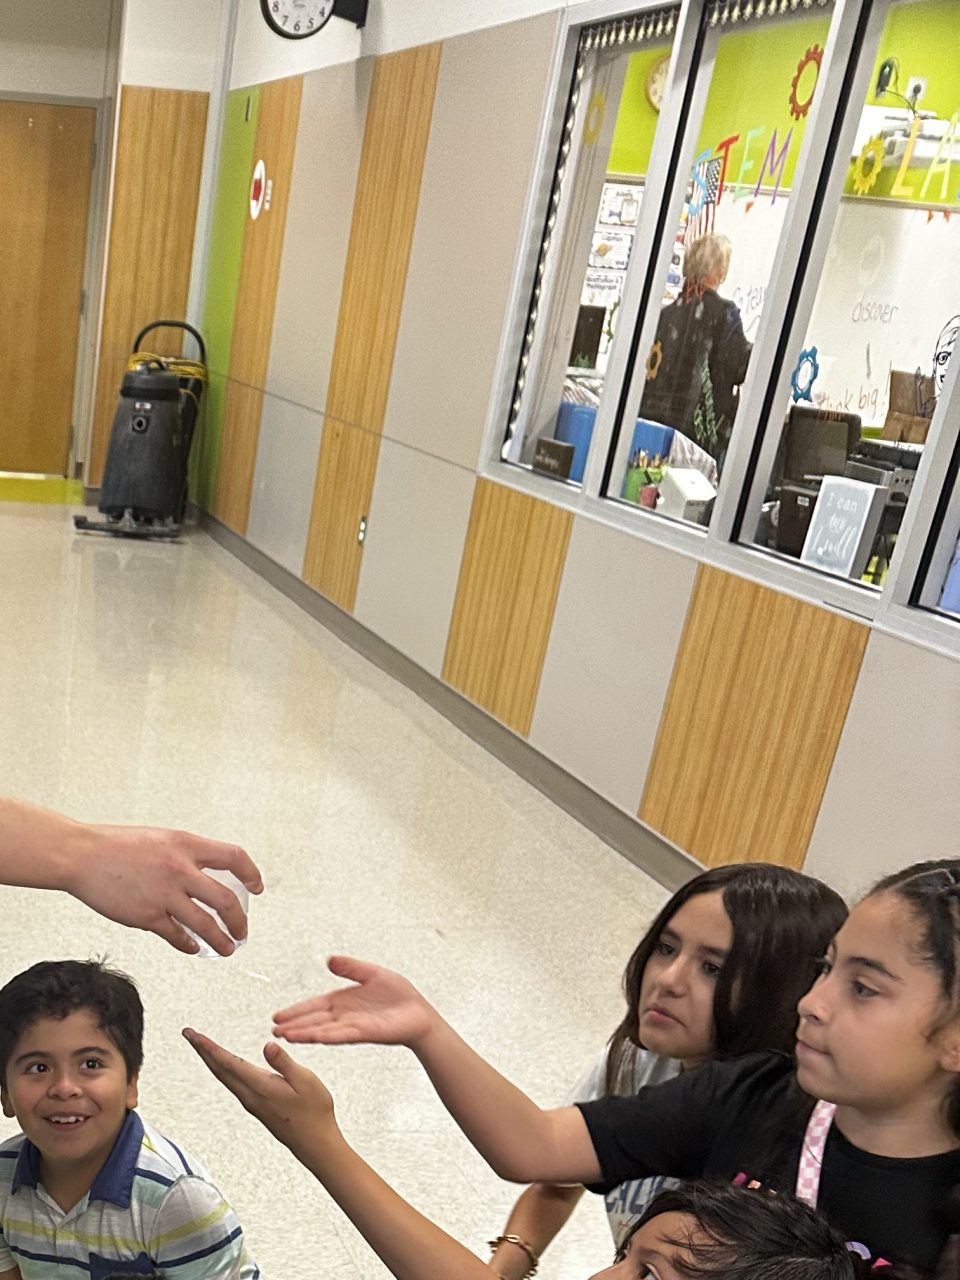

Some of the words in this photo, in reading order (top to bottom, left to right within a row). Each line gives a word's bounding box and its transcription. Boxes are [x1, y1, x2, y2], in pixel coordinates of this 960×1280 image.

[272, 1, 280, 13] 8
[319, 6, 326, 18] 4
[282, 15, 289, 26] 7
[293, 20, 301, 32] 6
[307, 17, 315, 29] 5
[688, 125, 794, 216] STEM
[890, 109, 960, 200] LA
[851, 290, 899, 324] discover
